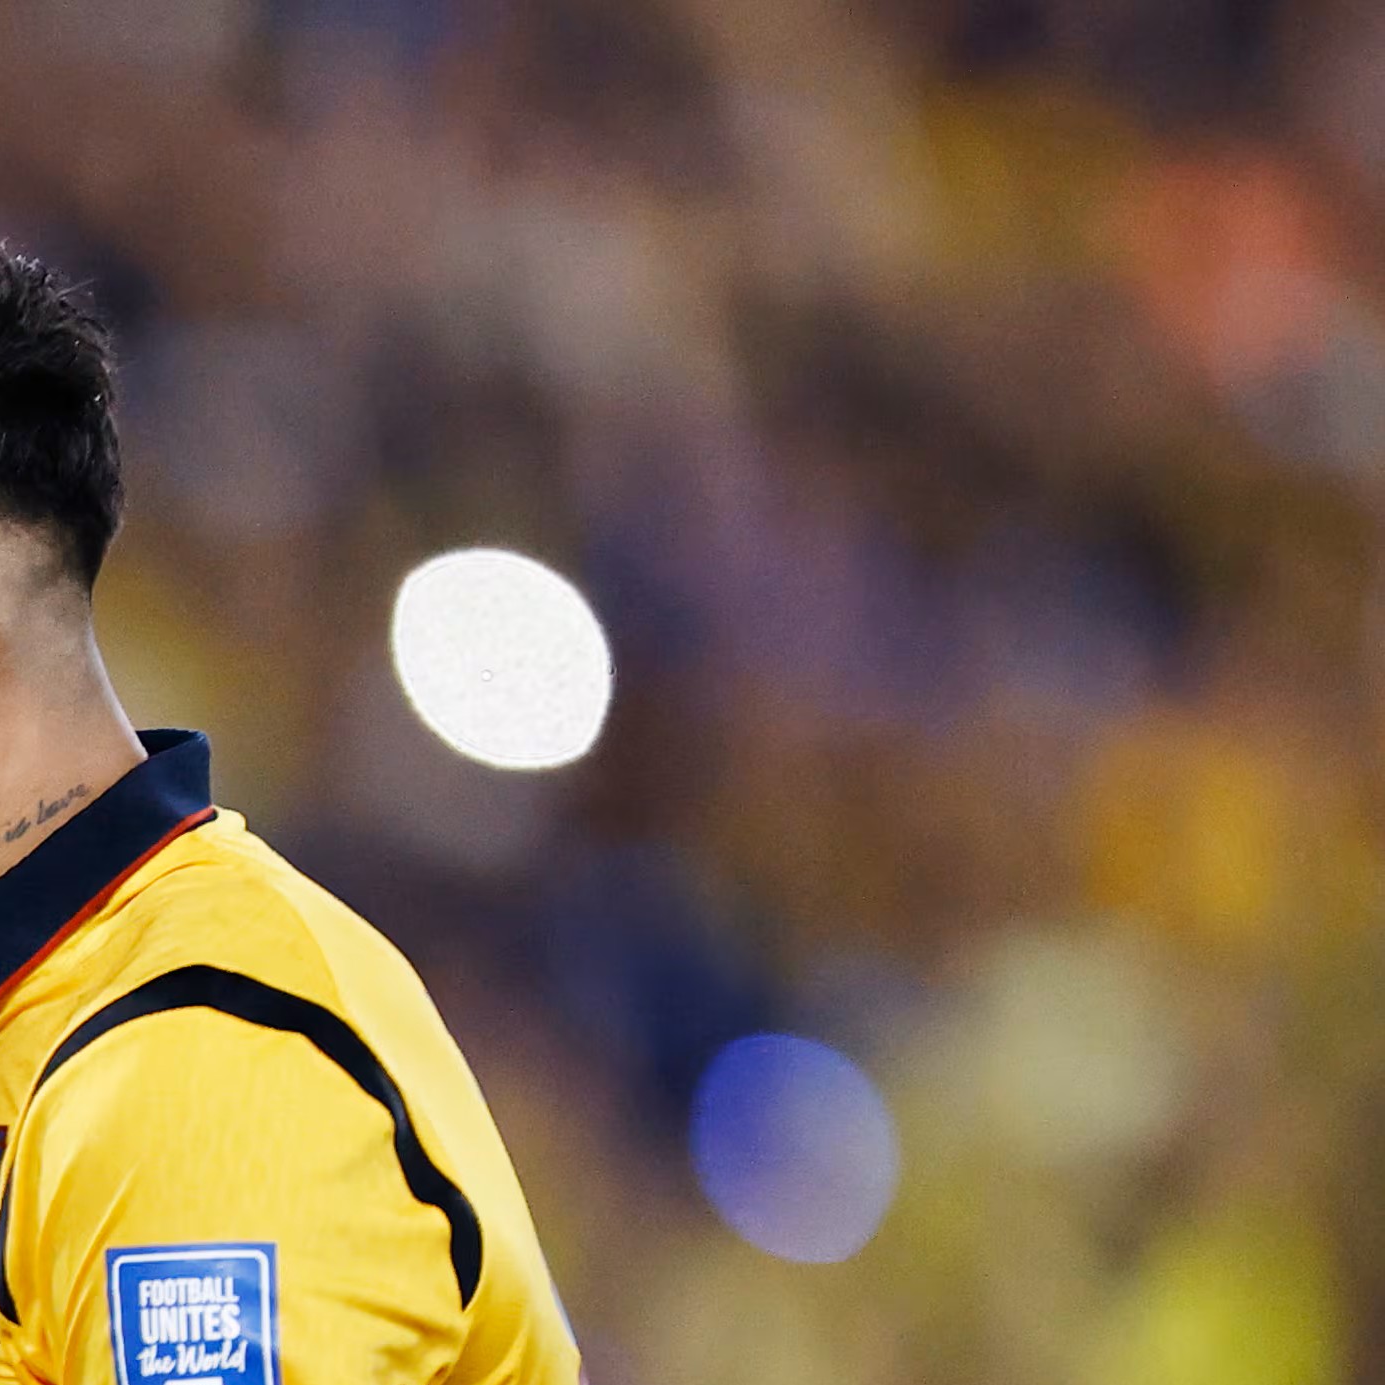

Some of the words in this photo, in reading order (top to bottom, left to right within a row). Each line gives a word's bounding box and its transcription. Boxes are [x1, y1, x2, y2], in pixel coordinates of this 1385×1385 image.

[138, 1276, 239, 1306] FOOTBALL
[140, 1304, 241, 1344] UNITES
[136, 1344, 177, 1377] the
[175, 1338, 248, 1376] World
